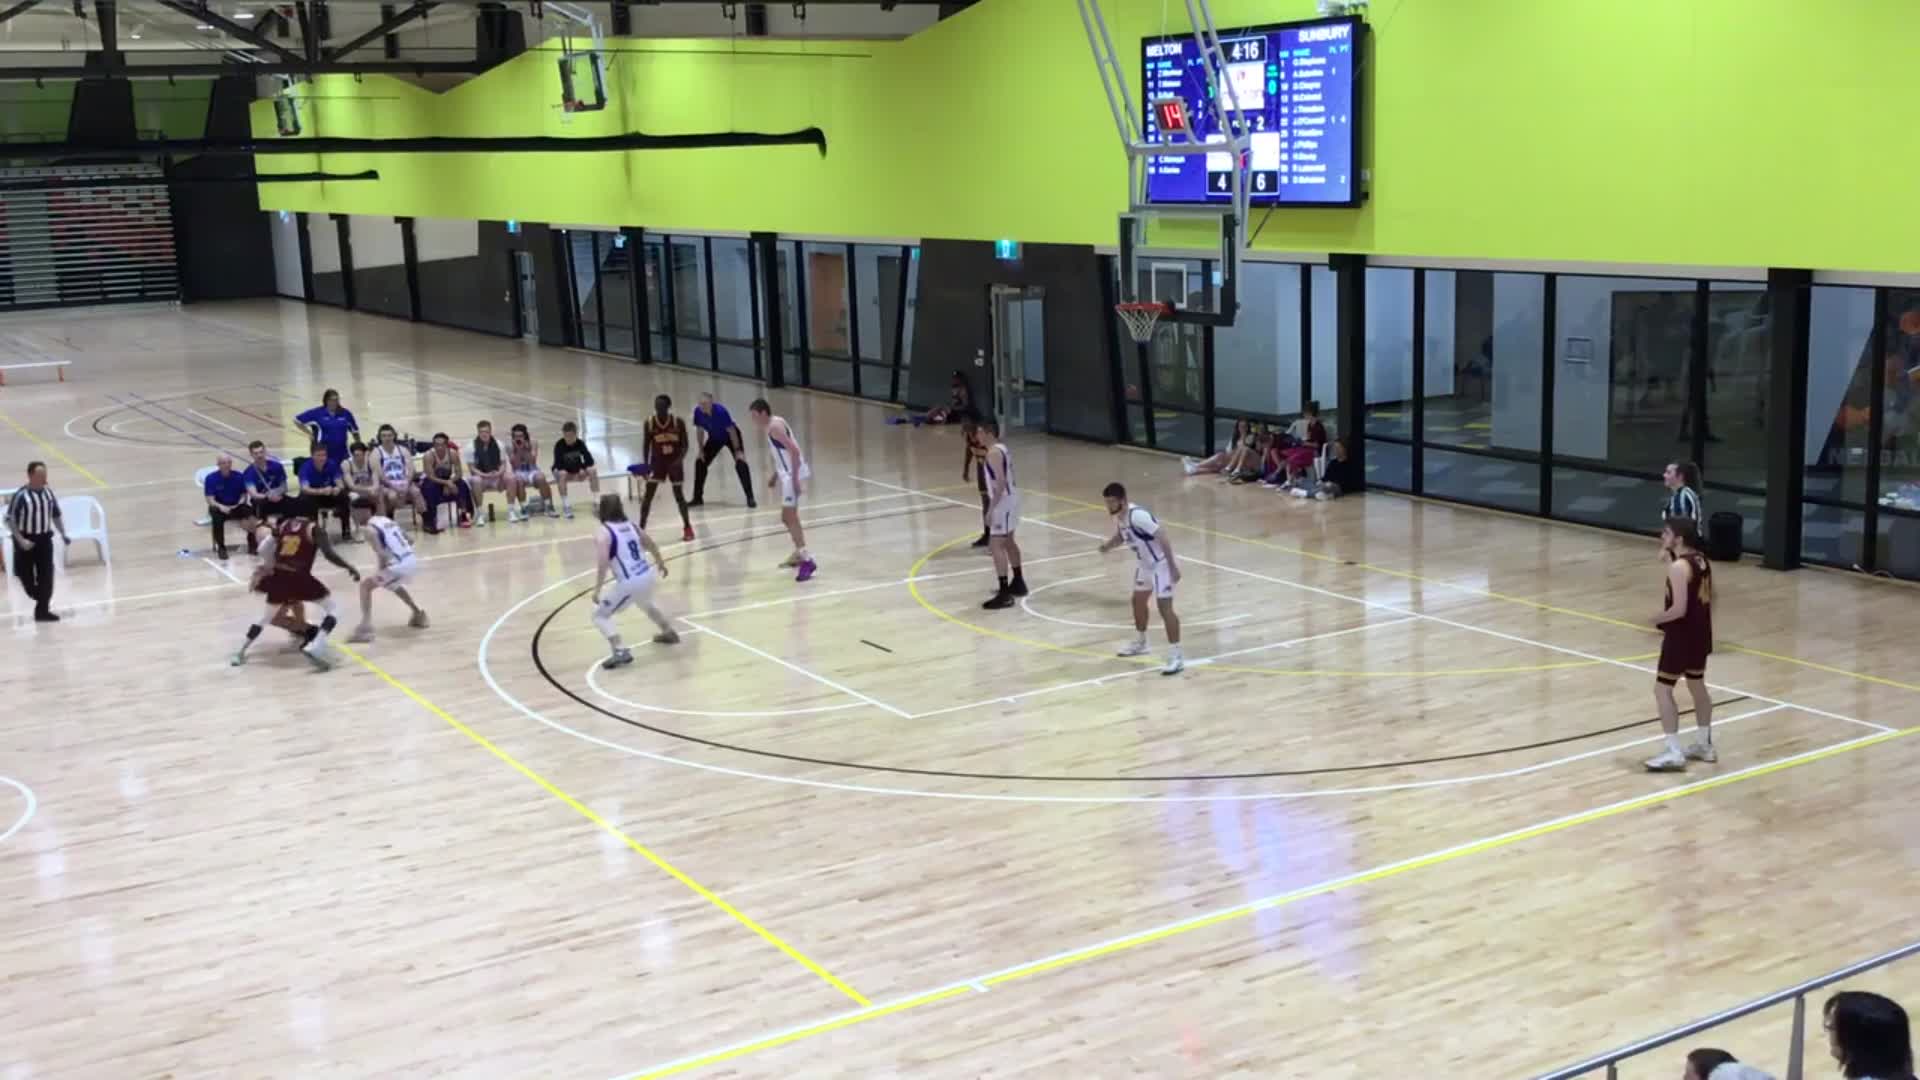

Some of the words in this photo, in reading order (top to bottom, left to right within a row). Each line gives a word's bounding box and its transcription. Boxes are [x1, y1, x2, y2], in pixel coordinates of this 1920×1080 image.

[1299, 26, 1350, 42] SUNBURY
[1146, 43, 1182, 57] MELTON
[1232, 42, 1259, 60] 4:16
[1164, 104, 1184, 129] 14
[1256, 115, 1265, 131] 2
[1217, 173, 1227, 190] 4
[1256, 172, 1266, 190] 6
[628, 539, 641, 561] 8
